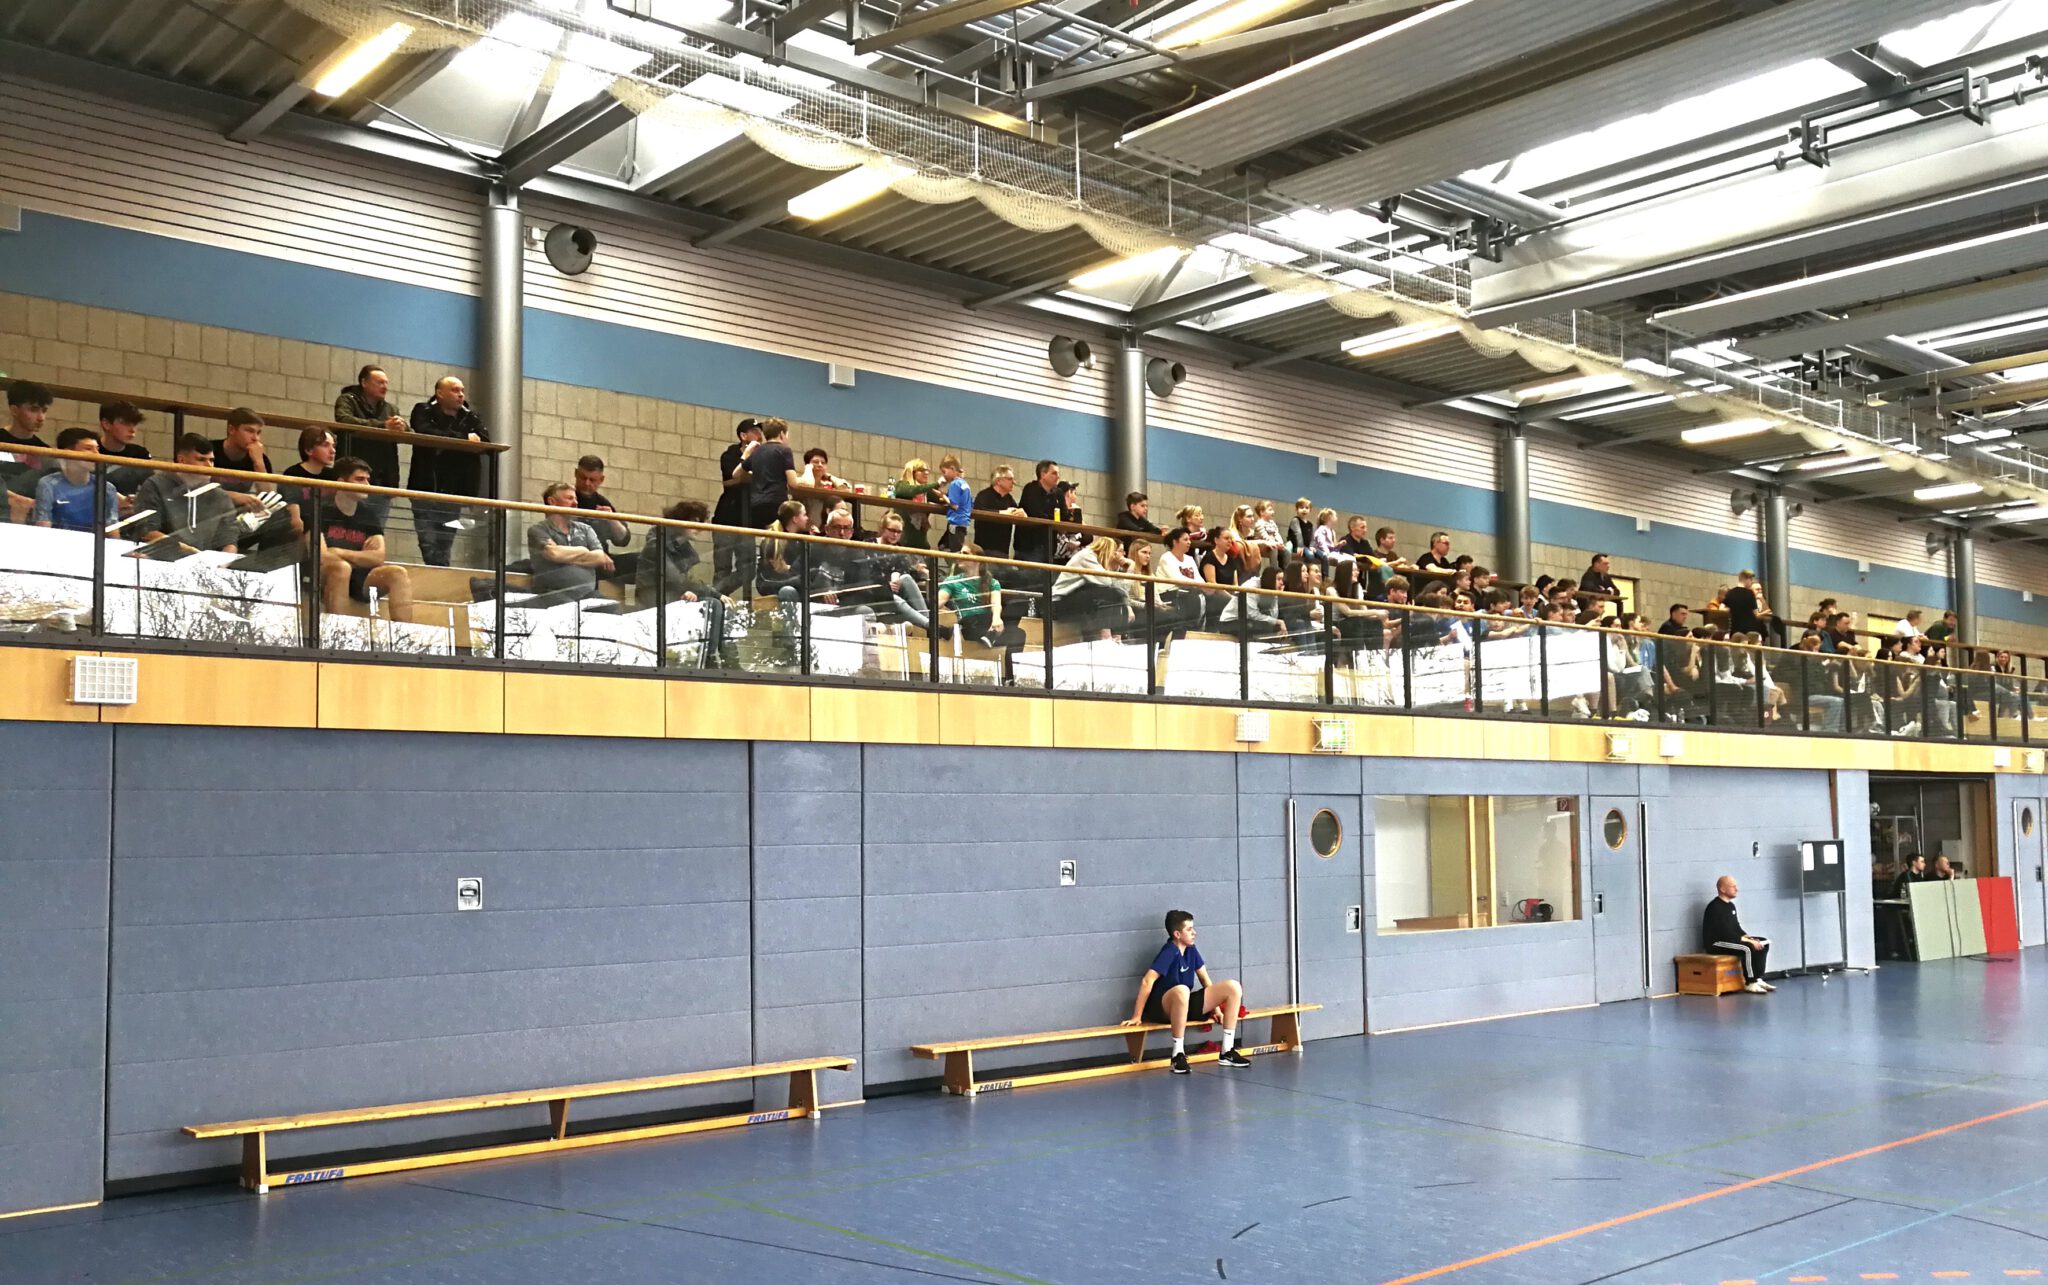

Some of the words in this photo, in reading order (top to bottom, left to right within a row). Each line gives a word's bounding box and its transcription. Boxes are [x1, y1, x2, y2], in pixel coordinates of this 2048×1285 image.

[979, 1081, 1013, 1091] FRATUFA
[748, 1110, 789, 1123] FRATUFA
[285, 1168, 345, 1184] FRATUFA
